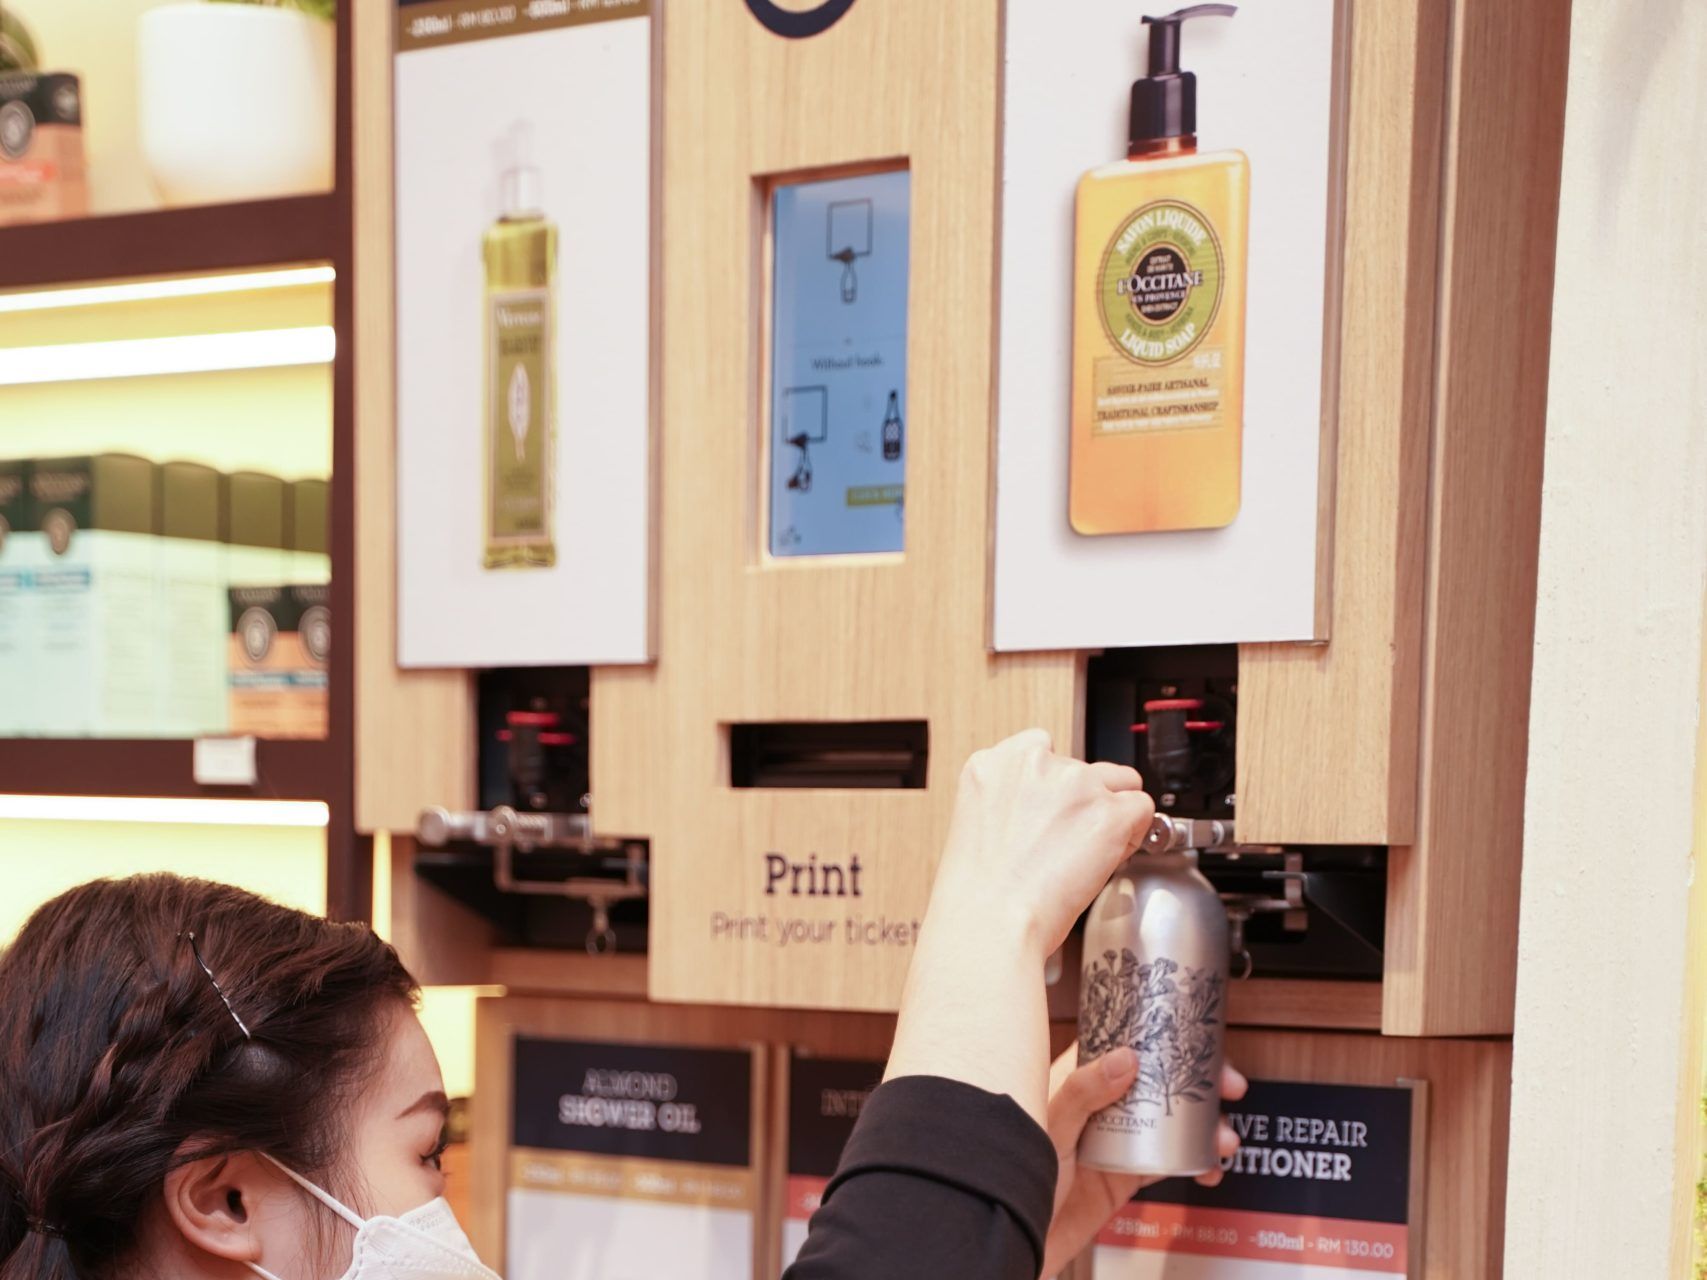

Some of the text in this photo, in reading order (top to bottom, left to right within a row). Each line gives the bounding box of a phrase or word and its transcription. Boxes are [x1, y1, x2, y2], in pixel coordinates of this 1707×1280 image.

[1117, 271, 1203, 294] L'OCCITANE
[1120, 328, 1164, 358] LIQUID
[1165, 322, 1197, 355] SOAP
[763, 853, 863, 897] Print
[710, 912, 767, 942] Print
[777, 918, 836, 947] your
[559, 1094, 702, 1133] SHOWER OIL
[1228, 1113, 1368, 1148] IVE REPAIR
[1220, 1145, 1352, 1181] ITIONER
[1316, 1236, 1341, 1253] RM
